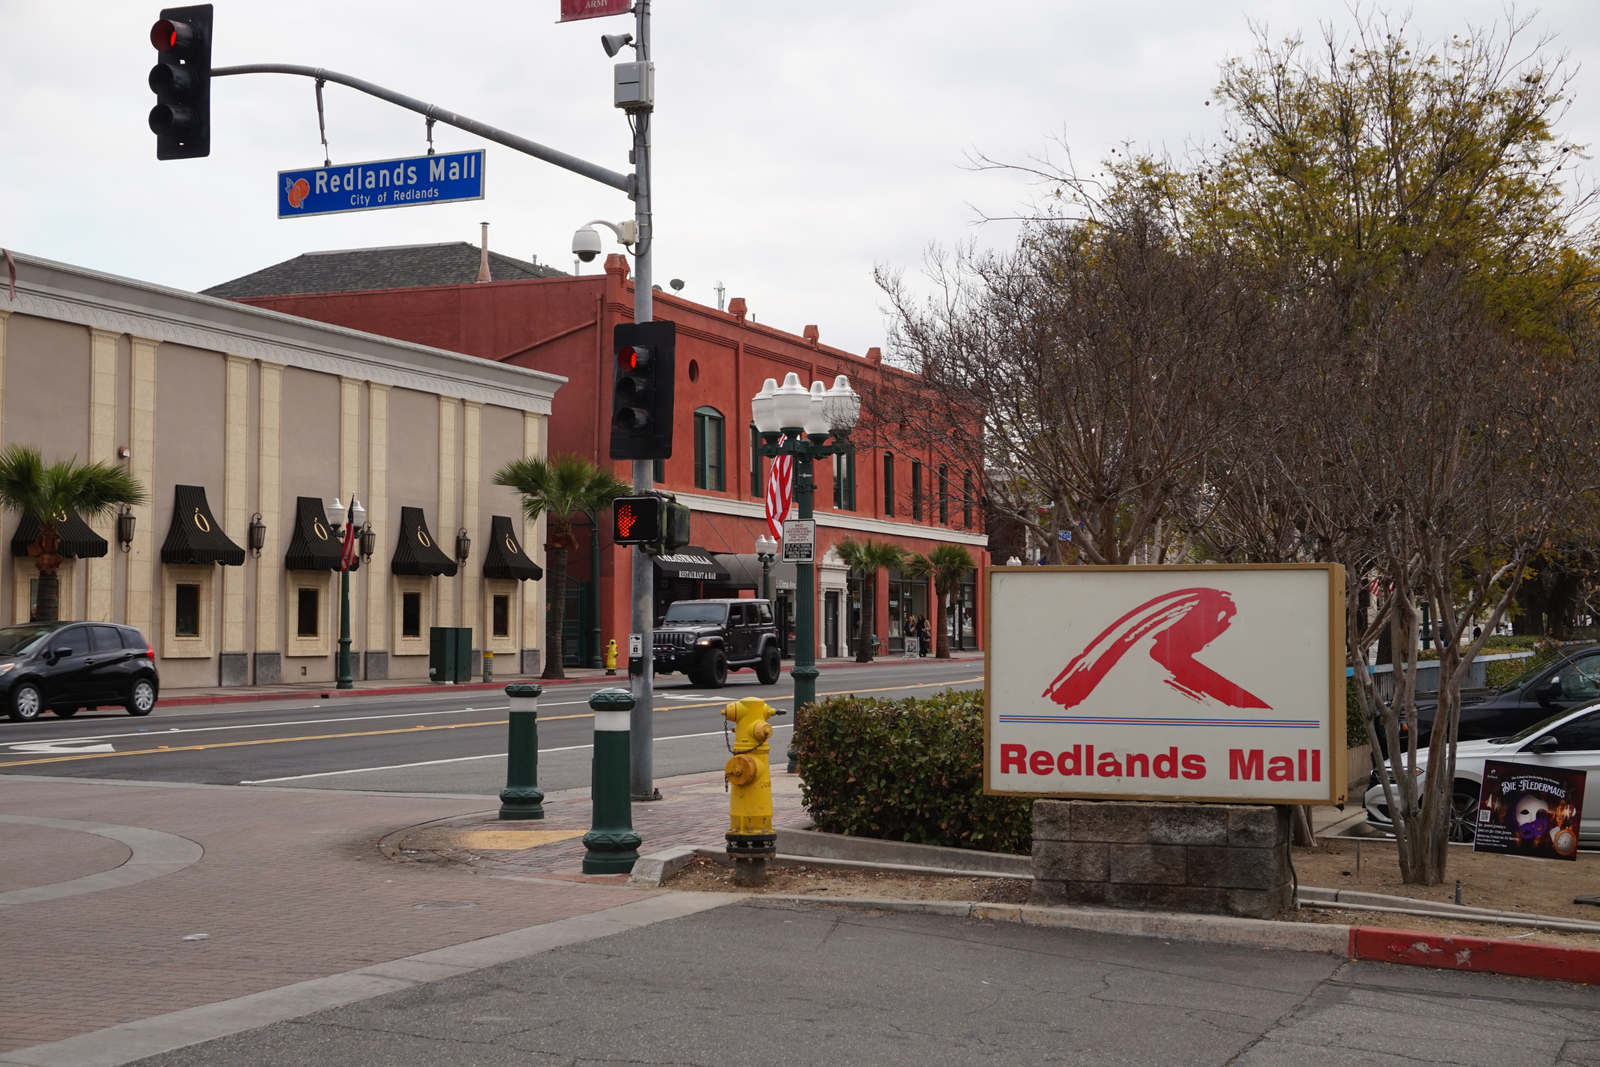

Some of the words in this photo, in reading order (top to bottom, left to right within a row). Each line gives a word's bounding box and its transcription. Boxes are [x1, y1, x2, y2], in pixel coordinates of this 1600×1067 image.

[585, 0, 608, 8] ARMY
[315, 163, 418, 194] Redlands
[429, 154, 476, 182] Mall
[350, 194, 371, 206] City
[377, 191, 387, 203] of
[393, 187, 439, 201] Redlands
[678, 570, 704, 580] RESTAURANT
[708, 572, 717, 580] BAR
[1000, 743, 1207, 780] Redlands
[1229, 749, 1321, 782] Mall
